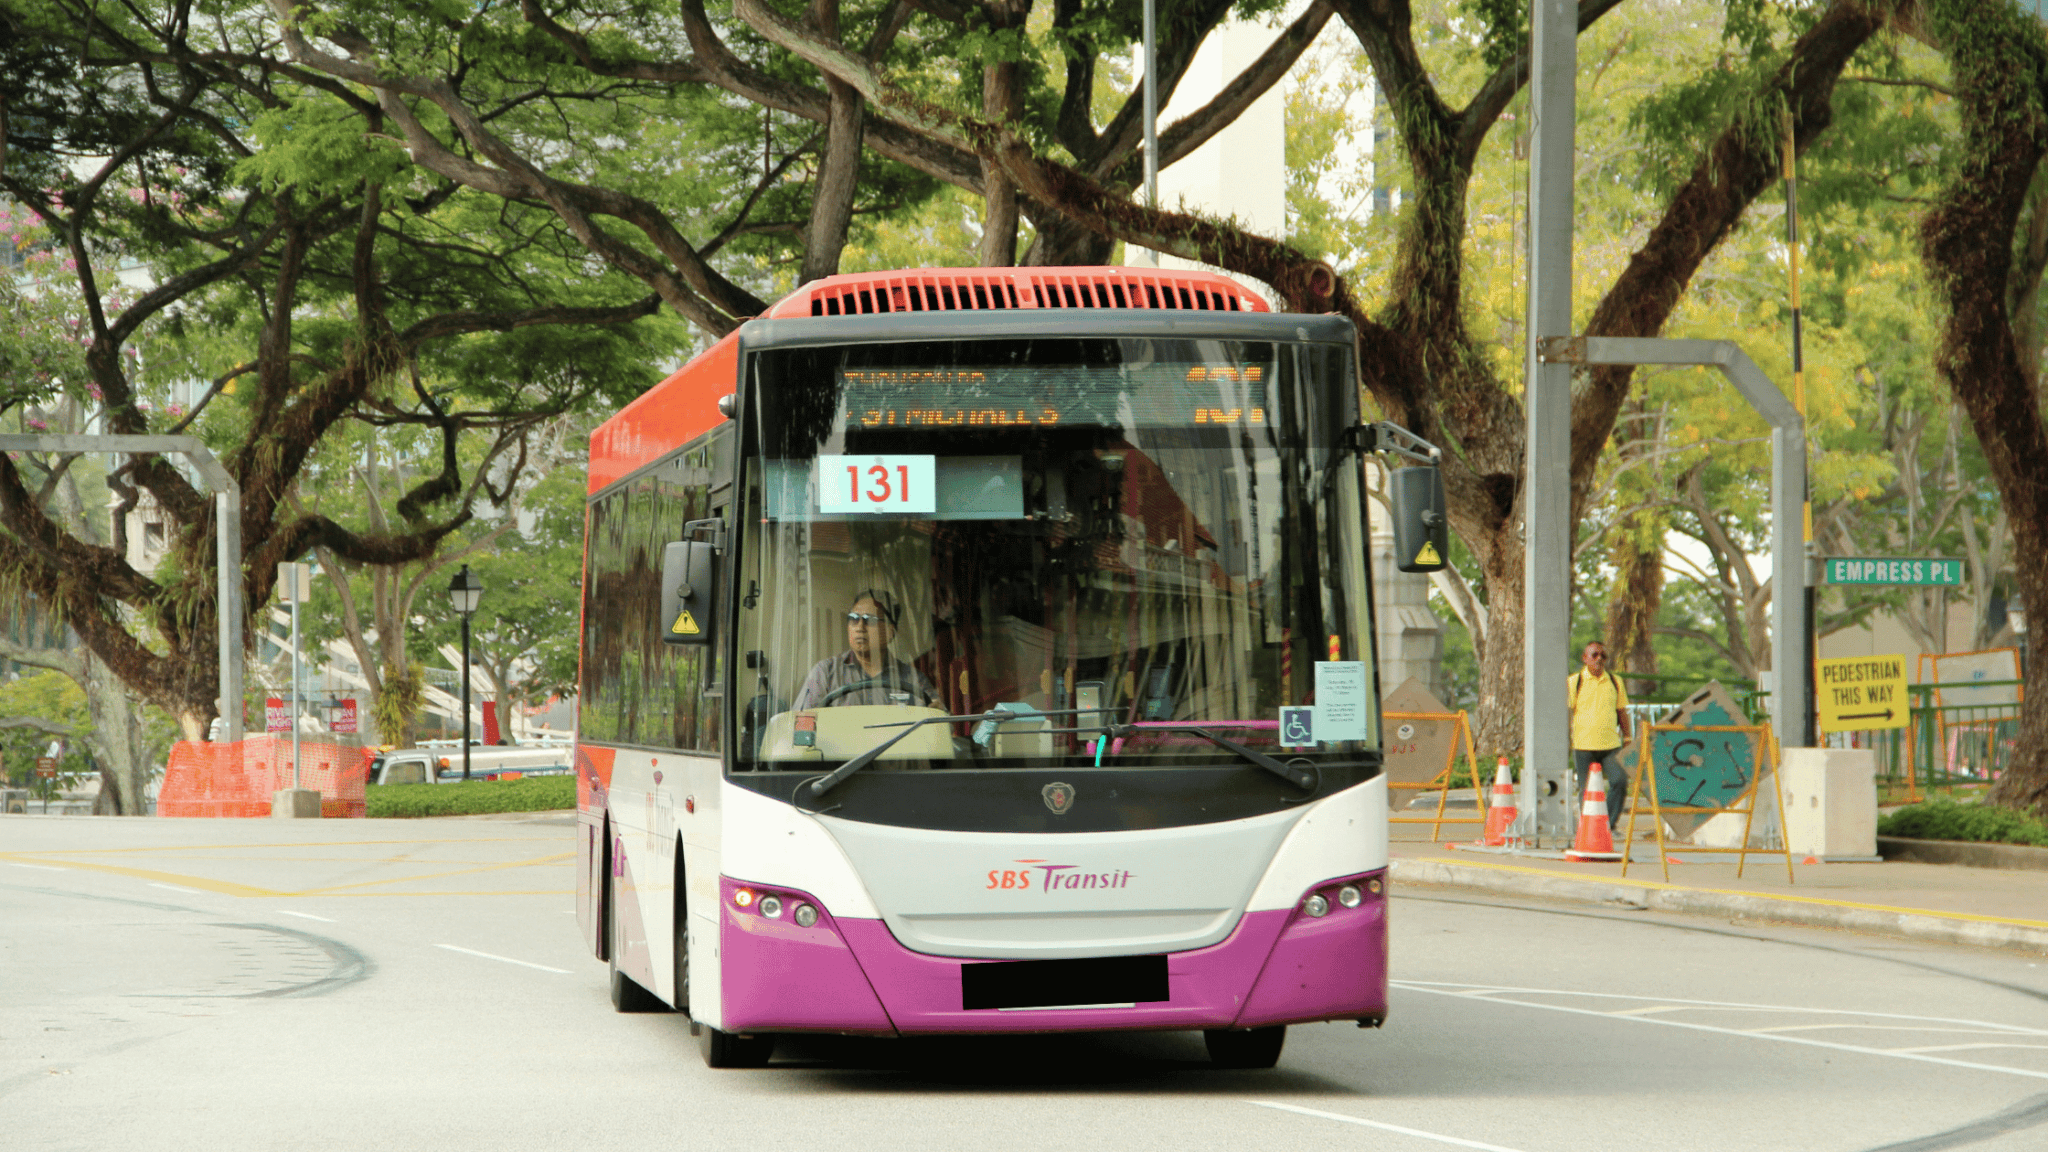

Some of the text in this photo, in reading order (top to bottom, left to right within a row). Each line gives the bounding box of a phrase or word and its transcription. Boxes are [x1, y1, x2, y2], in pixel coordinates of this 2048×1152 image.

[846, 465, 909, 502] 131
[1835, 561, 1953, 582] EMPRESS PL
[1822, 661, 1901, 684] PEDESTRIAN
[1832, 685, 1894, 706] THIS WAY
[986, 865, 1137, 894] SBS Transit
